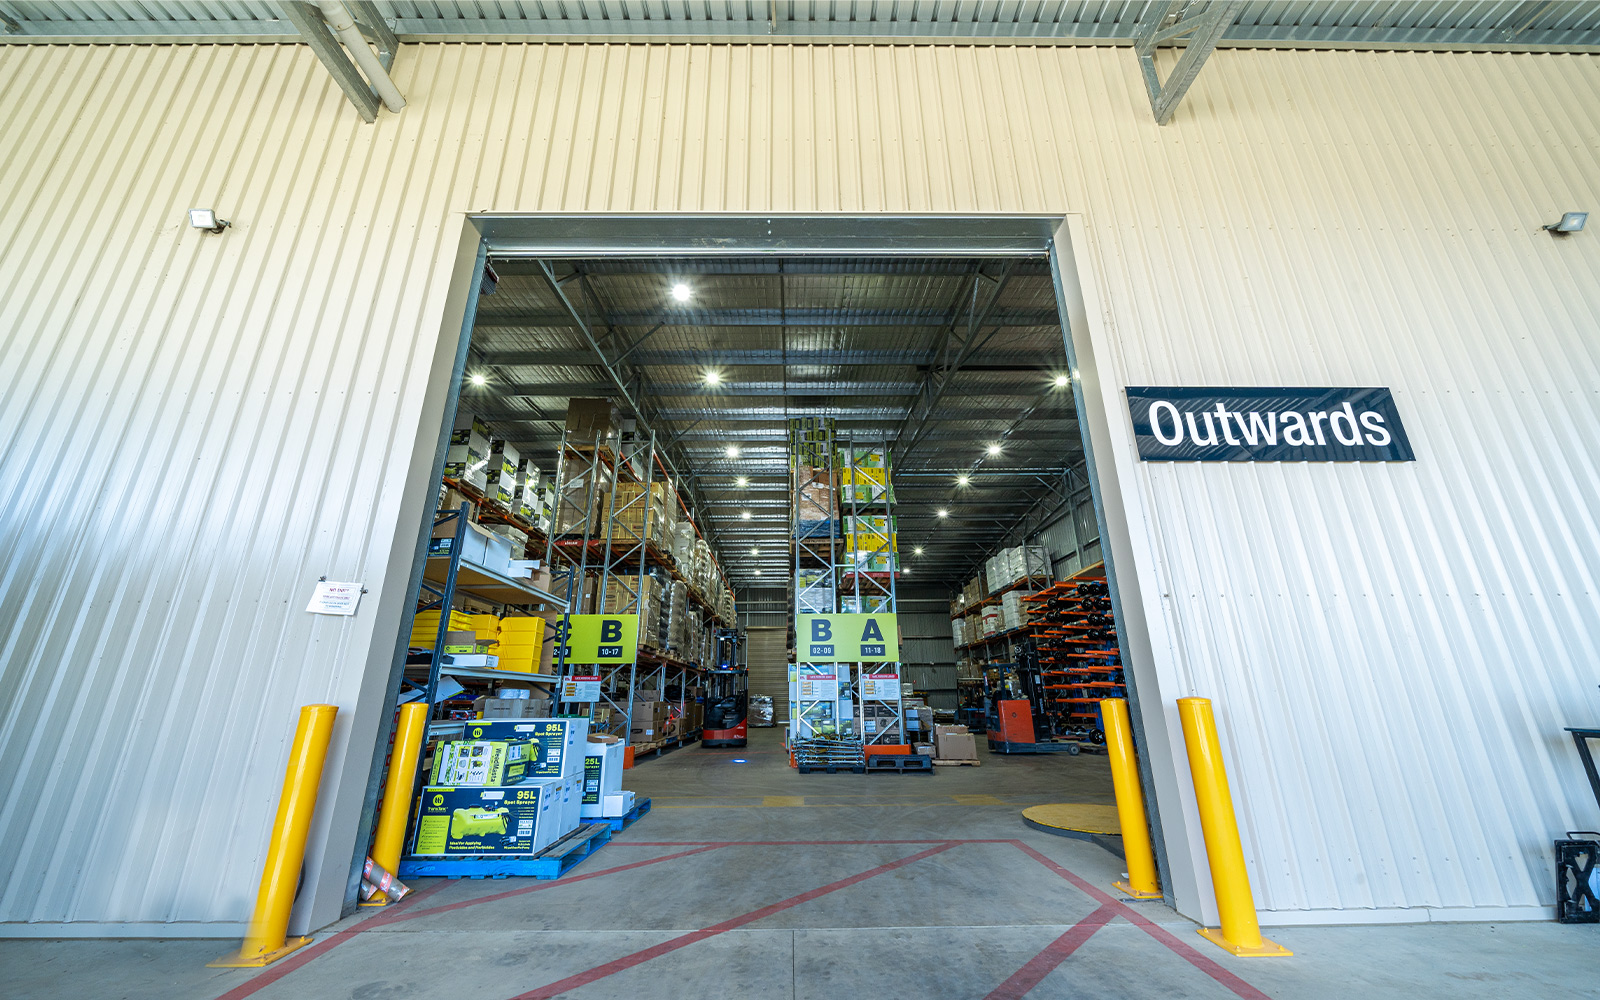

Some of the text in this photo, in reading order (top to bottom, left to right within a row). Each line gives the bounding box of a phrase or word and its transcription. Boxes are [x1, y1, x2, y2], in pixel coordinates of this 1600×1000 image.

[1149, 400, 1391, 446] Outwards
[600, 620, 622, 643] B
[811, 619, 832, 641] B
[861, 618, 884, 641] A
[601, 648, 619, 656] 10-17
[516, 790, 536, 799] 95L
